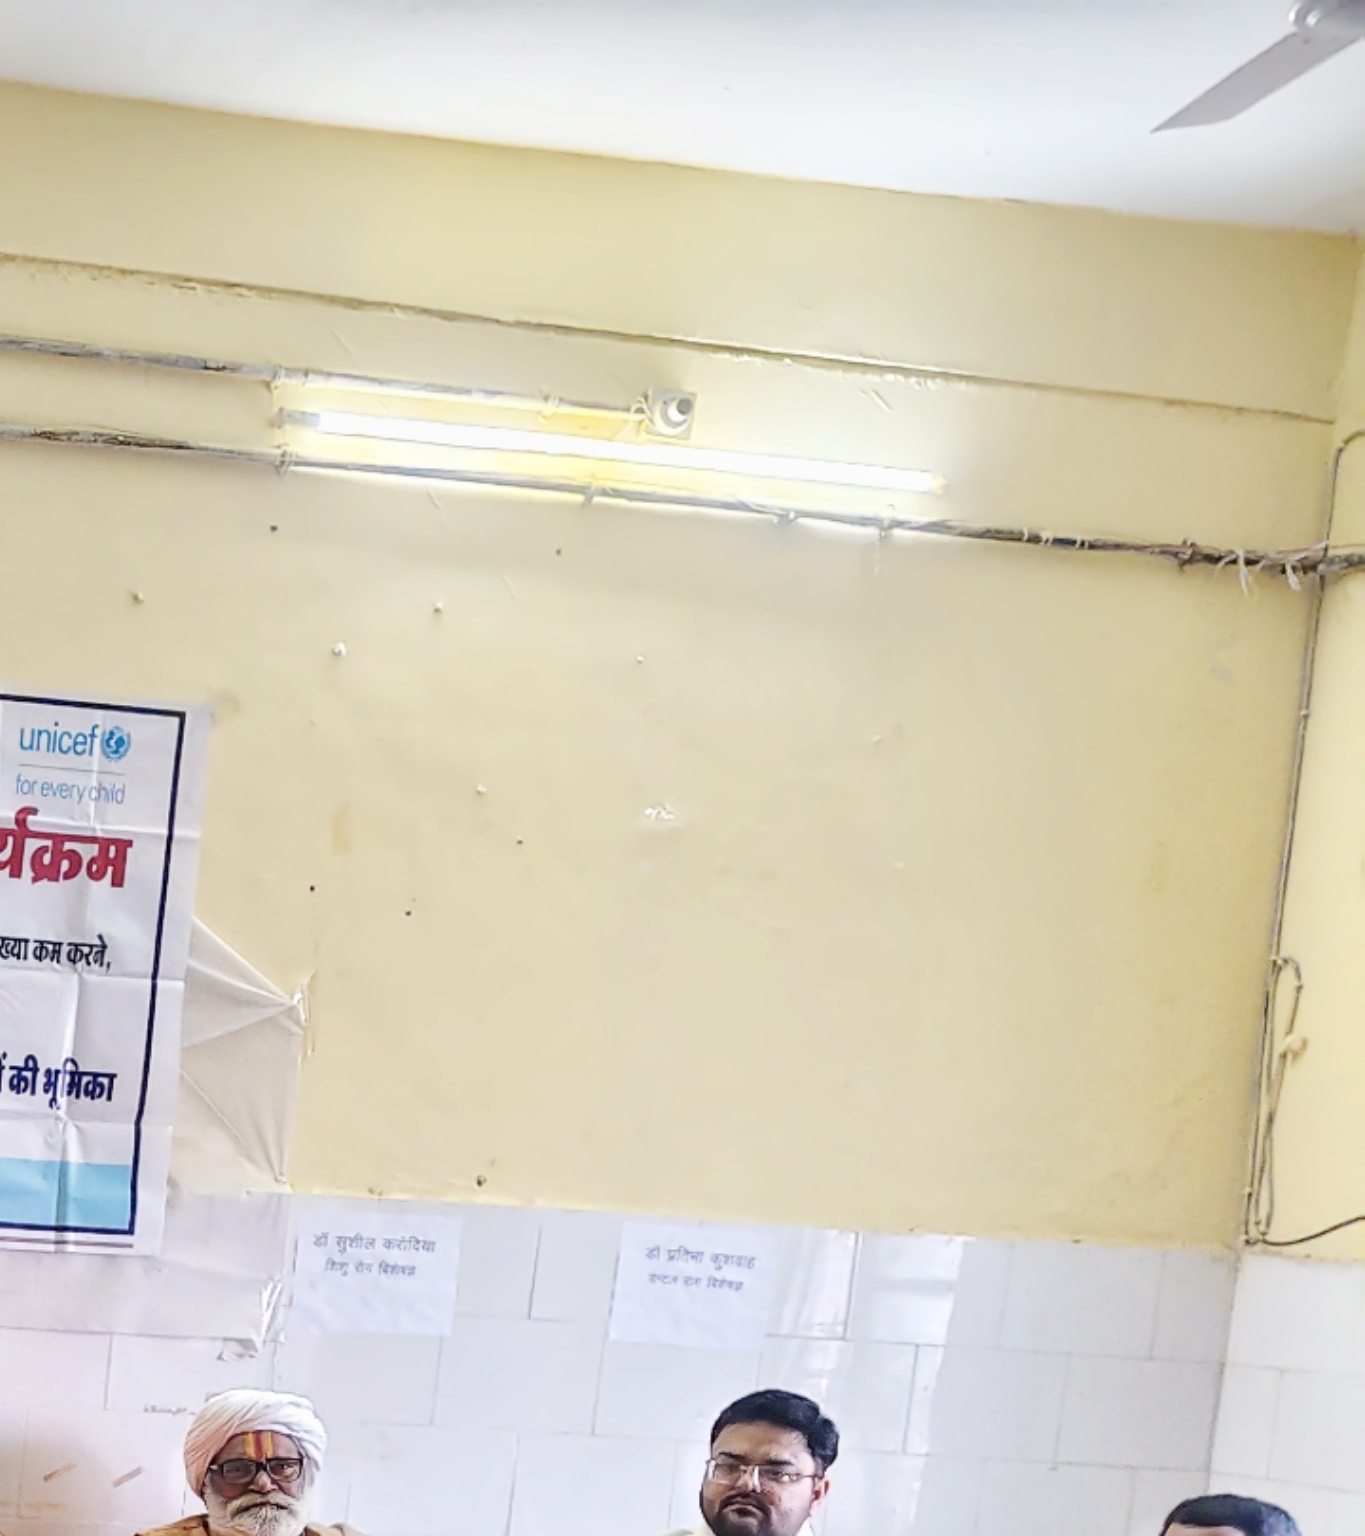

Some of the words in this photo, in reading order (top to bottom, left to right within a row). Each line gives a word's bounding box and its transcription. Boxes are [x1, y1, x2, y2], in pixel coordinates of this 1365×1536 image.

[20, 722, 99, 757] unicef
[16, 773, 38, 795] for
[41, 780, 86, 804] every
[88, 782, 126, 804] child
[33, 939, 64, 964] कम
[66, 934, 112, 973] करने,
[9, 1054, 40, 1096] की
[42, 1057, 117, 1110] भूमिका
[335, 1232, 376, 1254] सुशील
